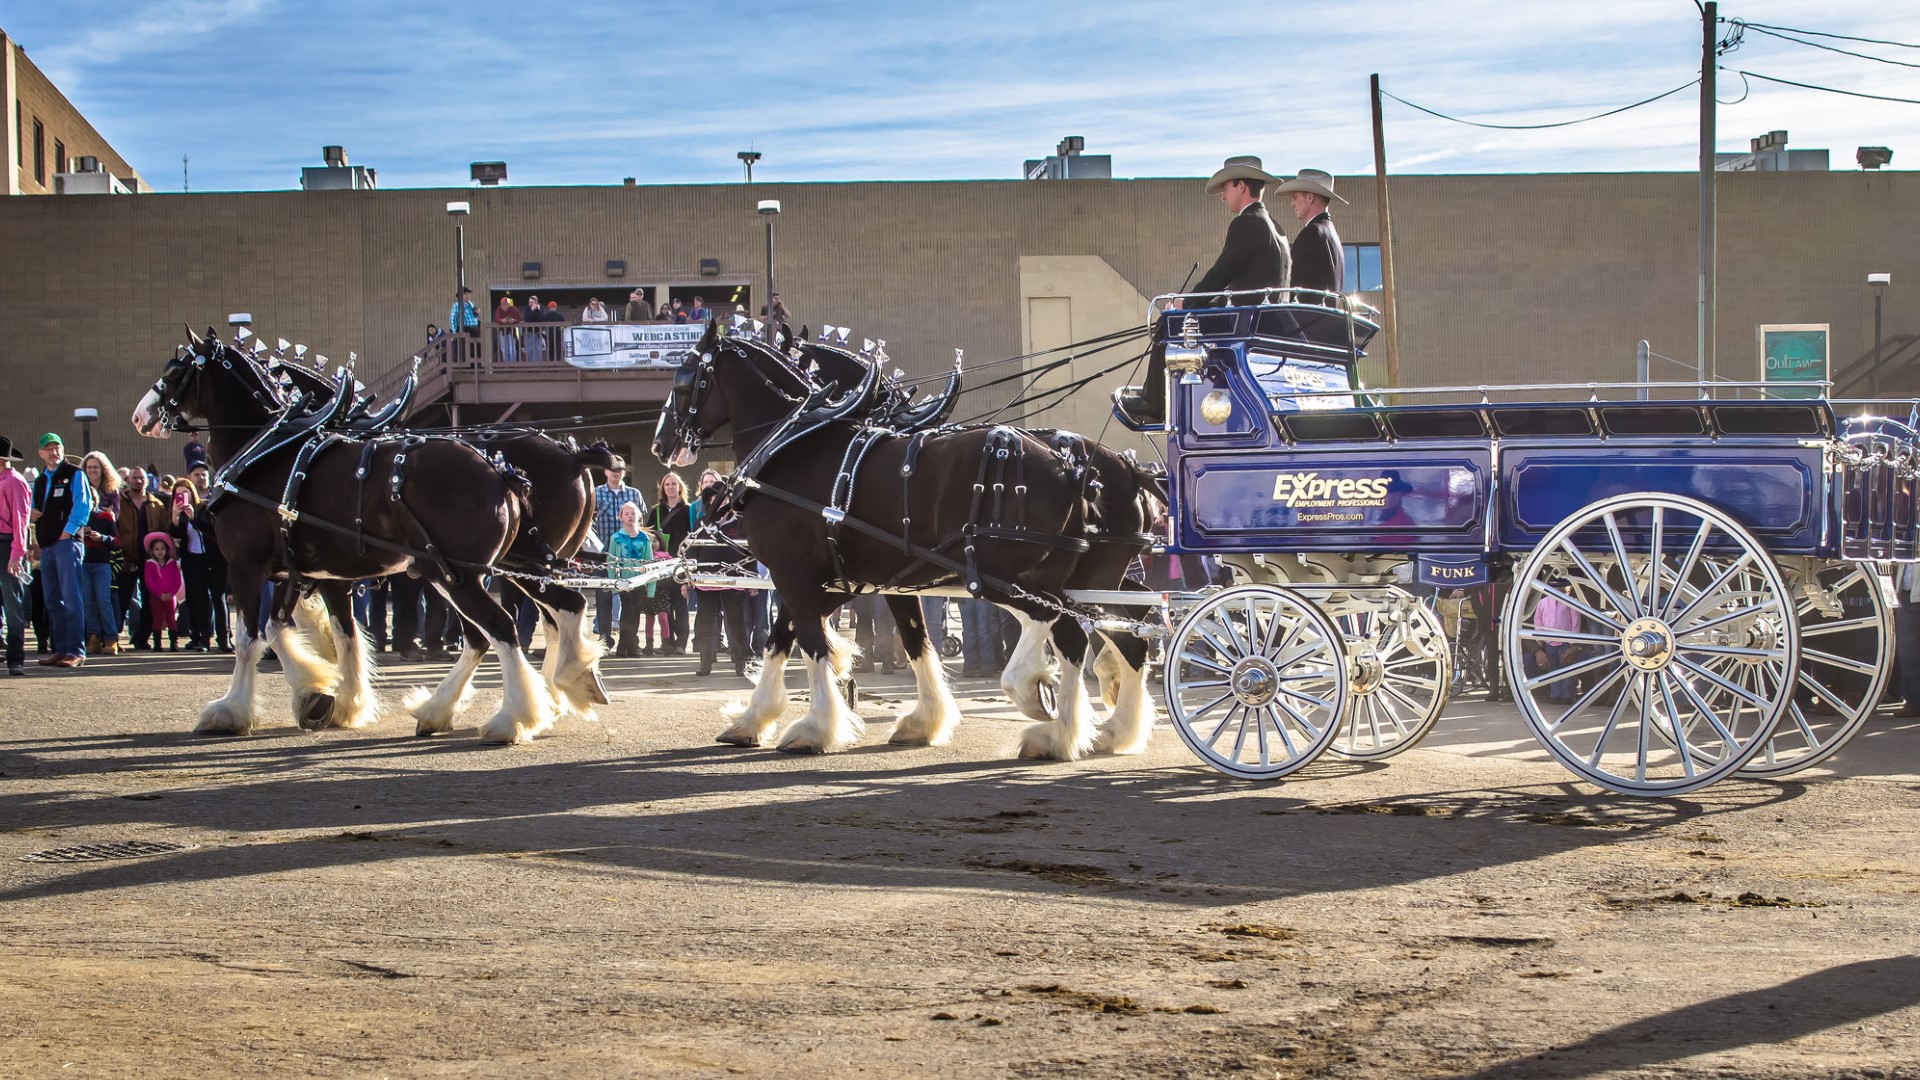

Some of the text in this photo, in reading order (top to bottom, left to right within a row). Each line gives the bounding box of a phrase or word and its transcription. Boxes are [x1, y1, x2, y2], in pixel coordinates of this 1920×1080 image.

[632, 331, 703, 341] WEBCASTING
[1295, 499, 1385, 508] EMPLOYMENT PROFESSIONALS
[1297, 513, 1363, 522] ExpressPros.com
[1430, 565, 1475, 579] FUNK
